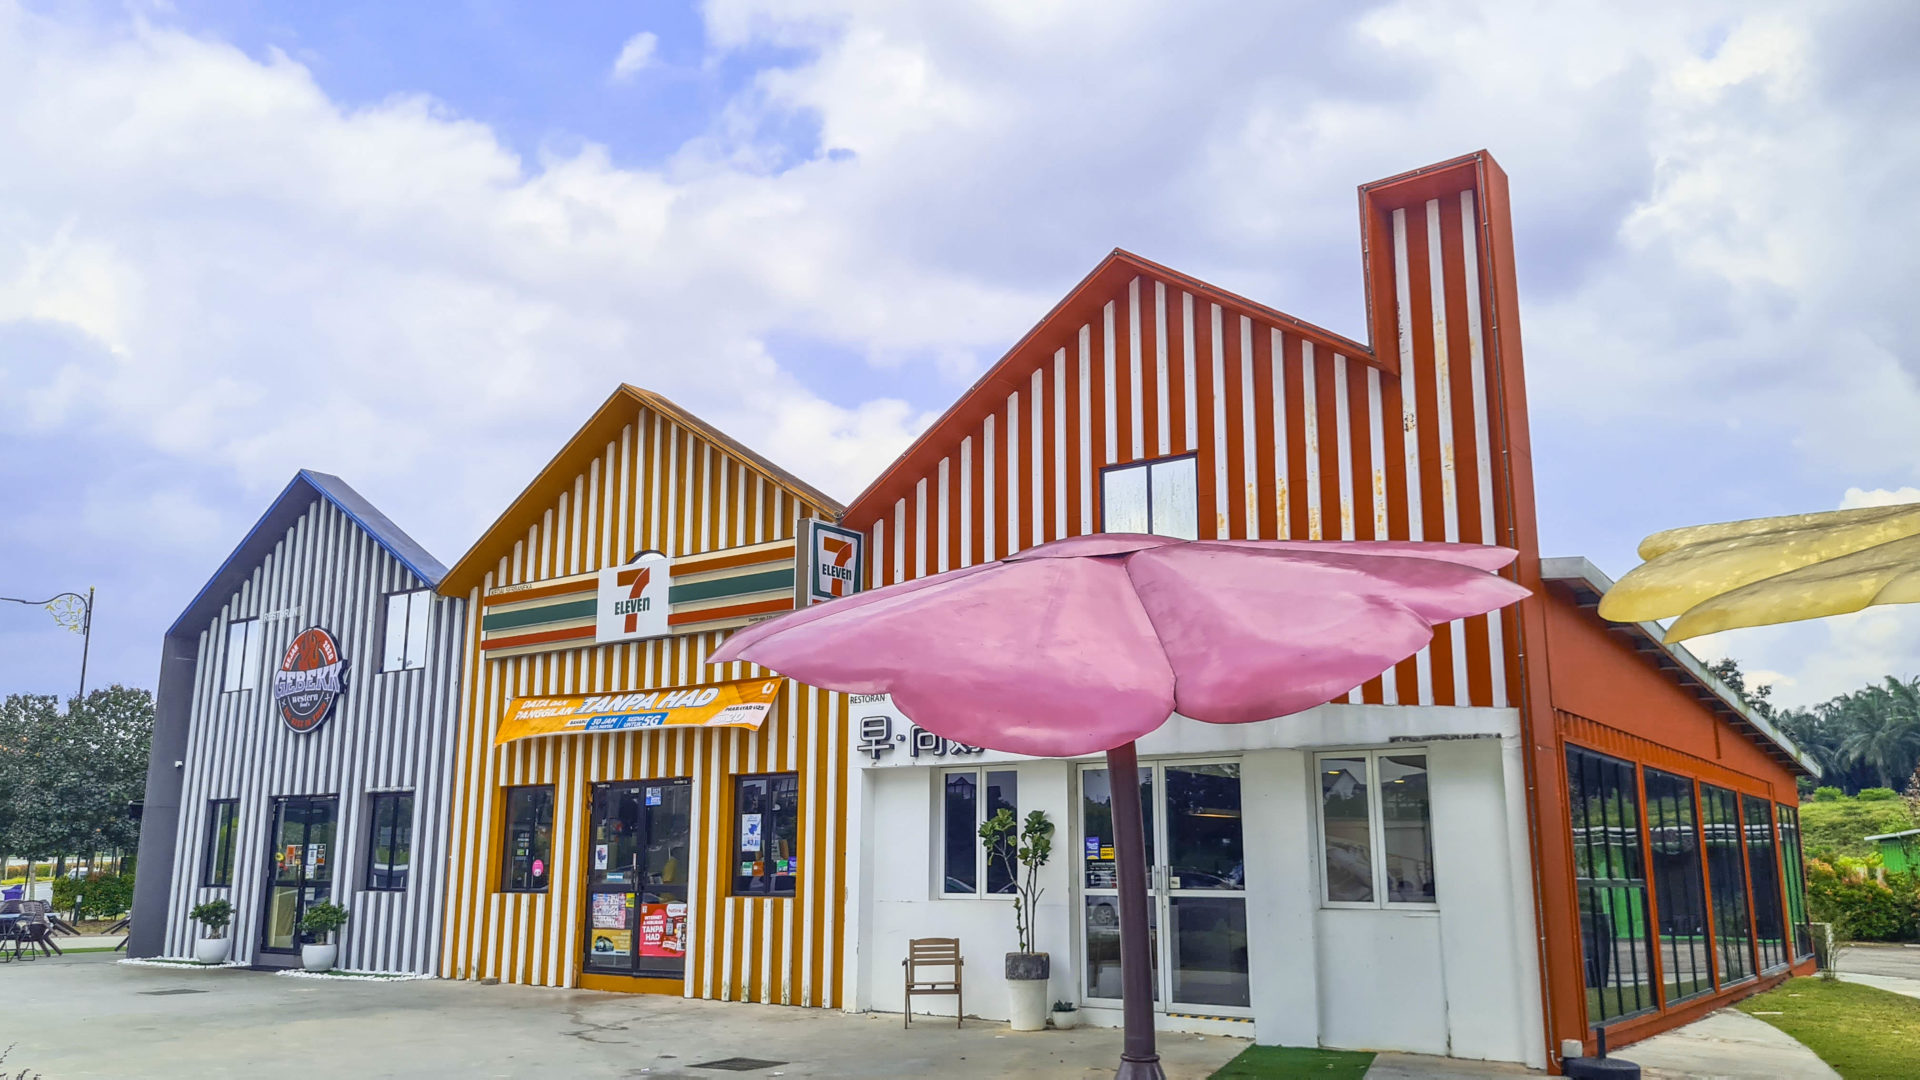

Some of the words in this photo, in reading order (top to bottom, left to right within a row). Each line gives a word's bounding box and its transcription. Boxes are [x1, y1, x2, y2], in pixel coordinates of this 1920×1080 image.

[824, 536, 852, 597] 7
[617, 567, 651, 633] 7
[275, 661, 343, 699] GEBEKK
[521, 699, 550, 709] DATA
[574, 692, 660, 714] TANPA
[656, 687, 719, 709] HAD
[850, 694, 885, 704] RESTORAN
[514, 707, 576, 720] PANGGILAN
[601, 717, 619, 725] JAM
[643, 715, 661, 726] 5G
[642, 925, 664, 933] TANPA
[645, 933, 661, 941] HAD
